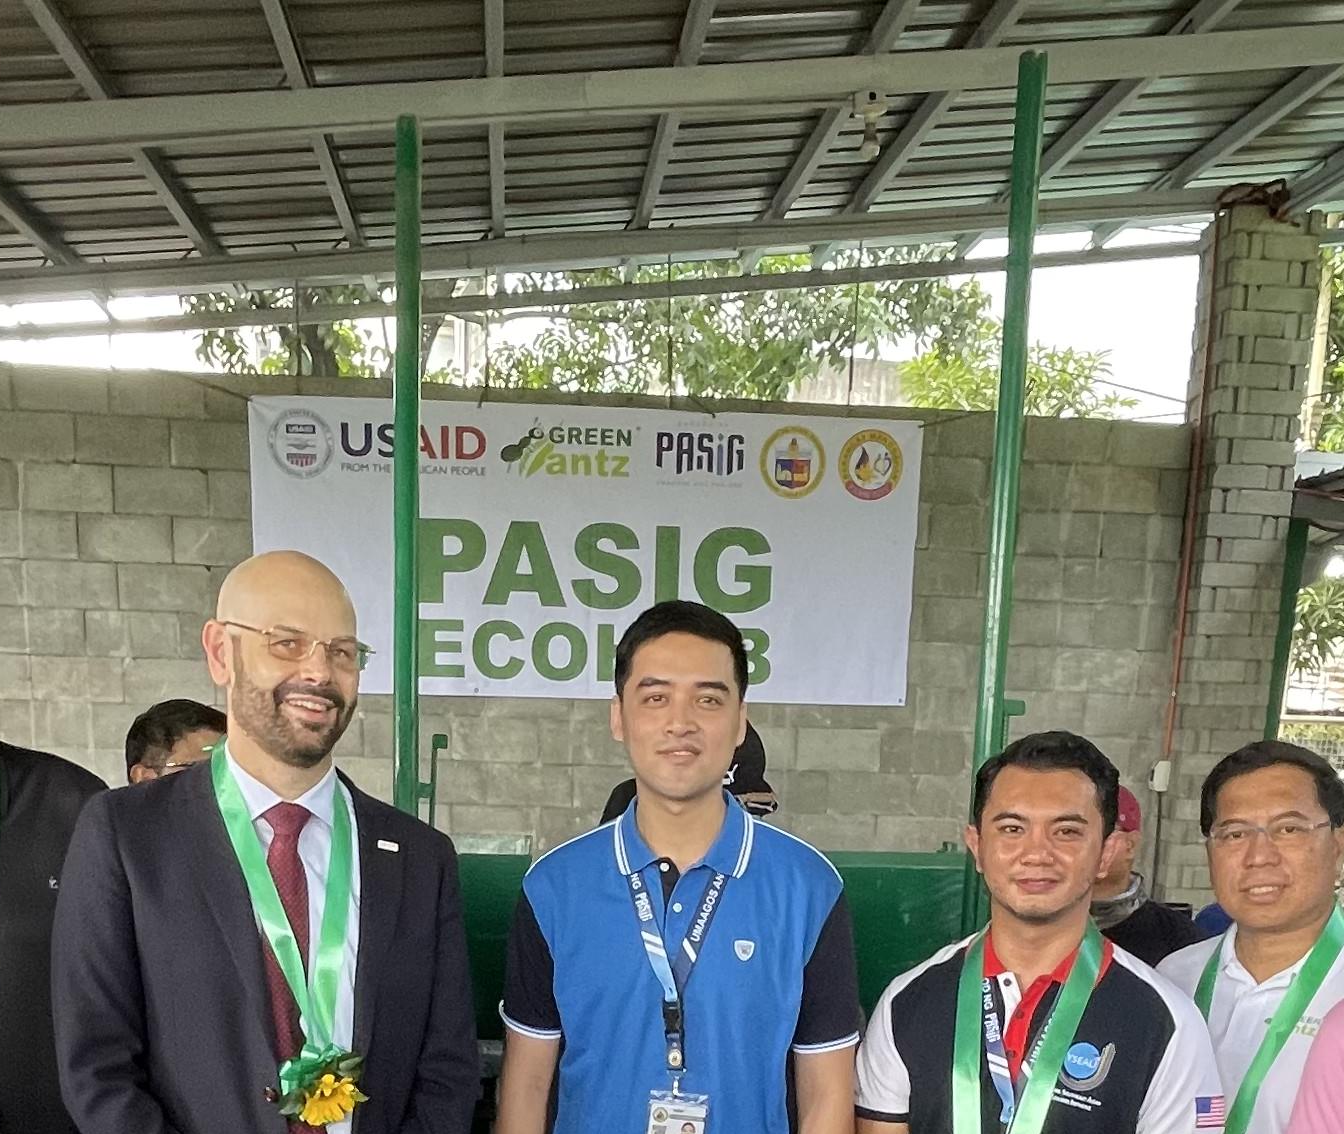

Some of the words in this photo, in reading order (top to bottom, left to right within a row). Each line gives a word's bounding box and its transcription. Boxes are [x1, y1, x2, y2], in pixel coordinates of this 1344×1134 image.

[340, 422, 487, 460] USAID
[548, 426, 632, 447] GREEN
[340, 462, 370, 473] FROM
[372, 463, 392, 474] THE
[450, 465, 486, 477] PEOPLE
[545, 448, 630, 477] antz
[418, 517, 773, 614] PASIG
[630, 872, 642, 890] NG
[689, 888, 719, 942] UMAAGOS
[983, 993, 994, 1011] NG
